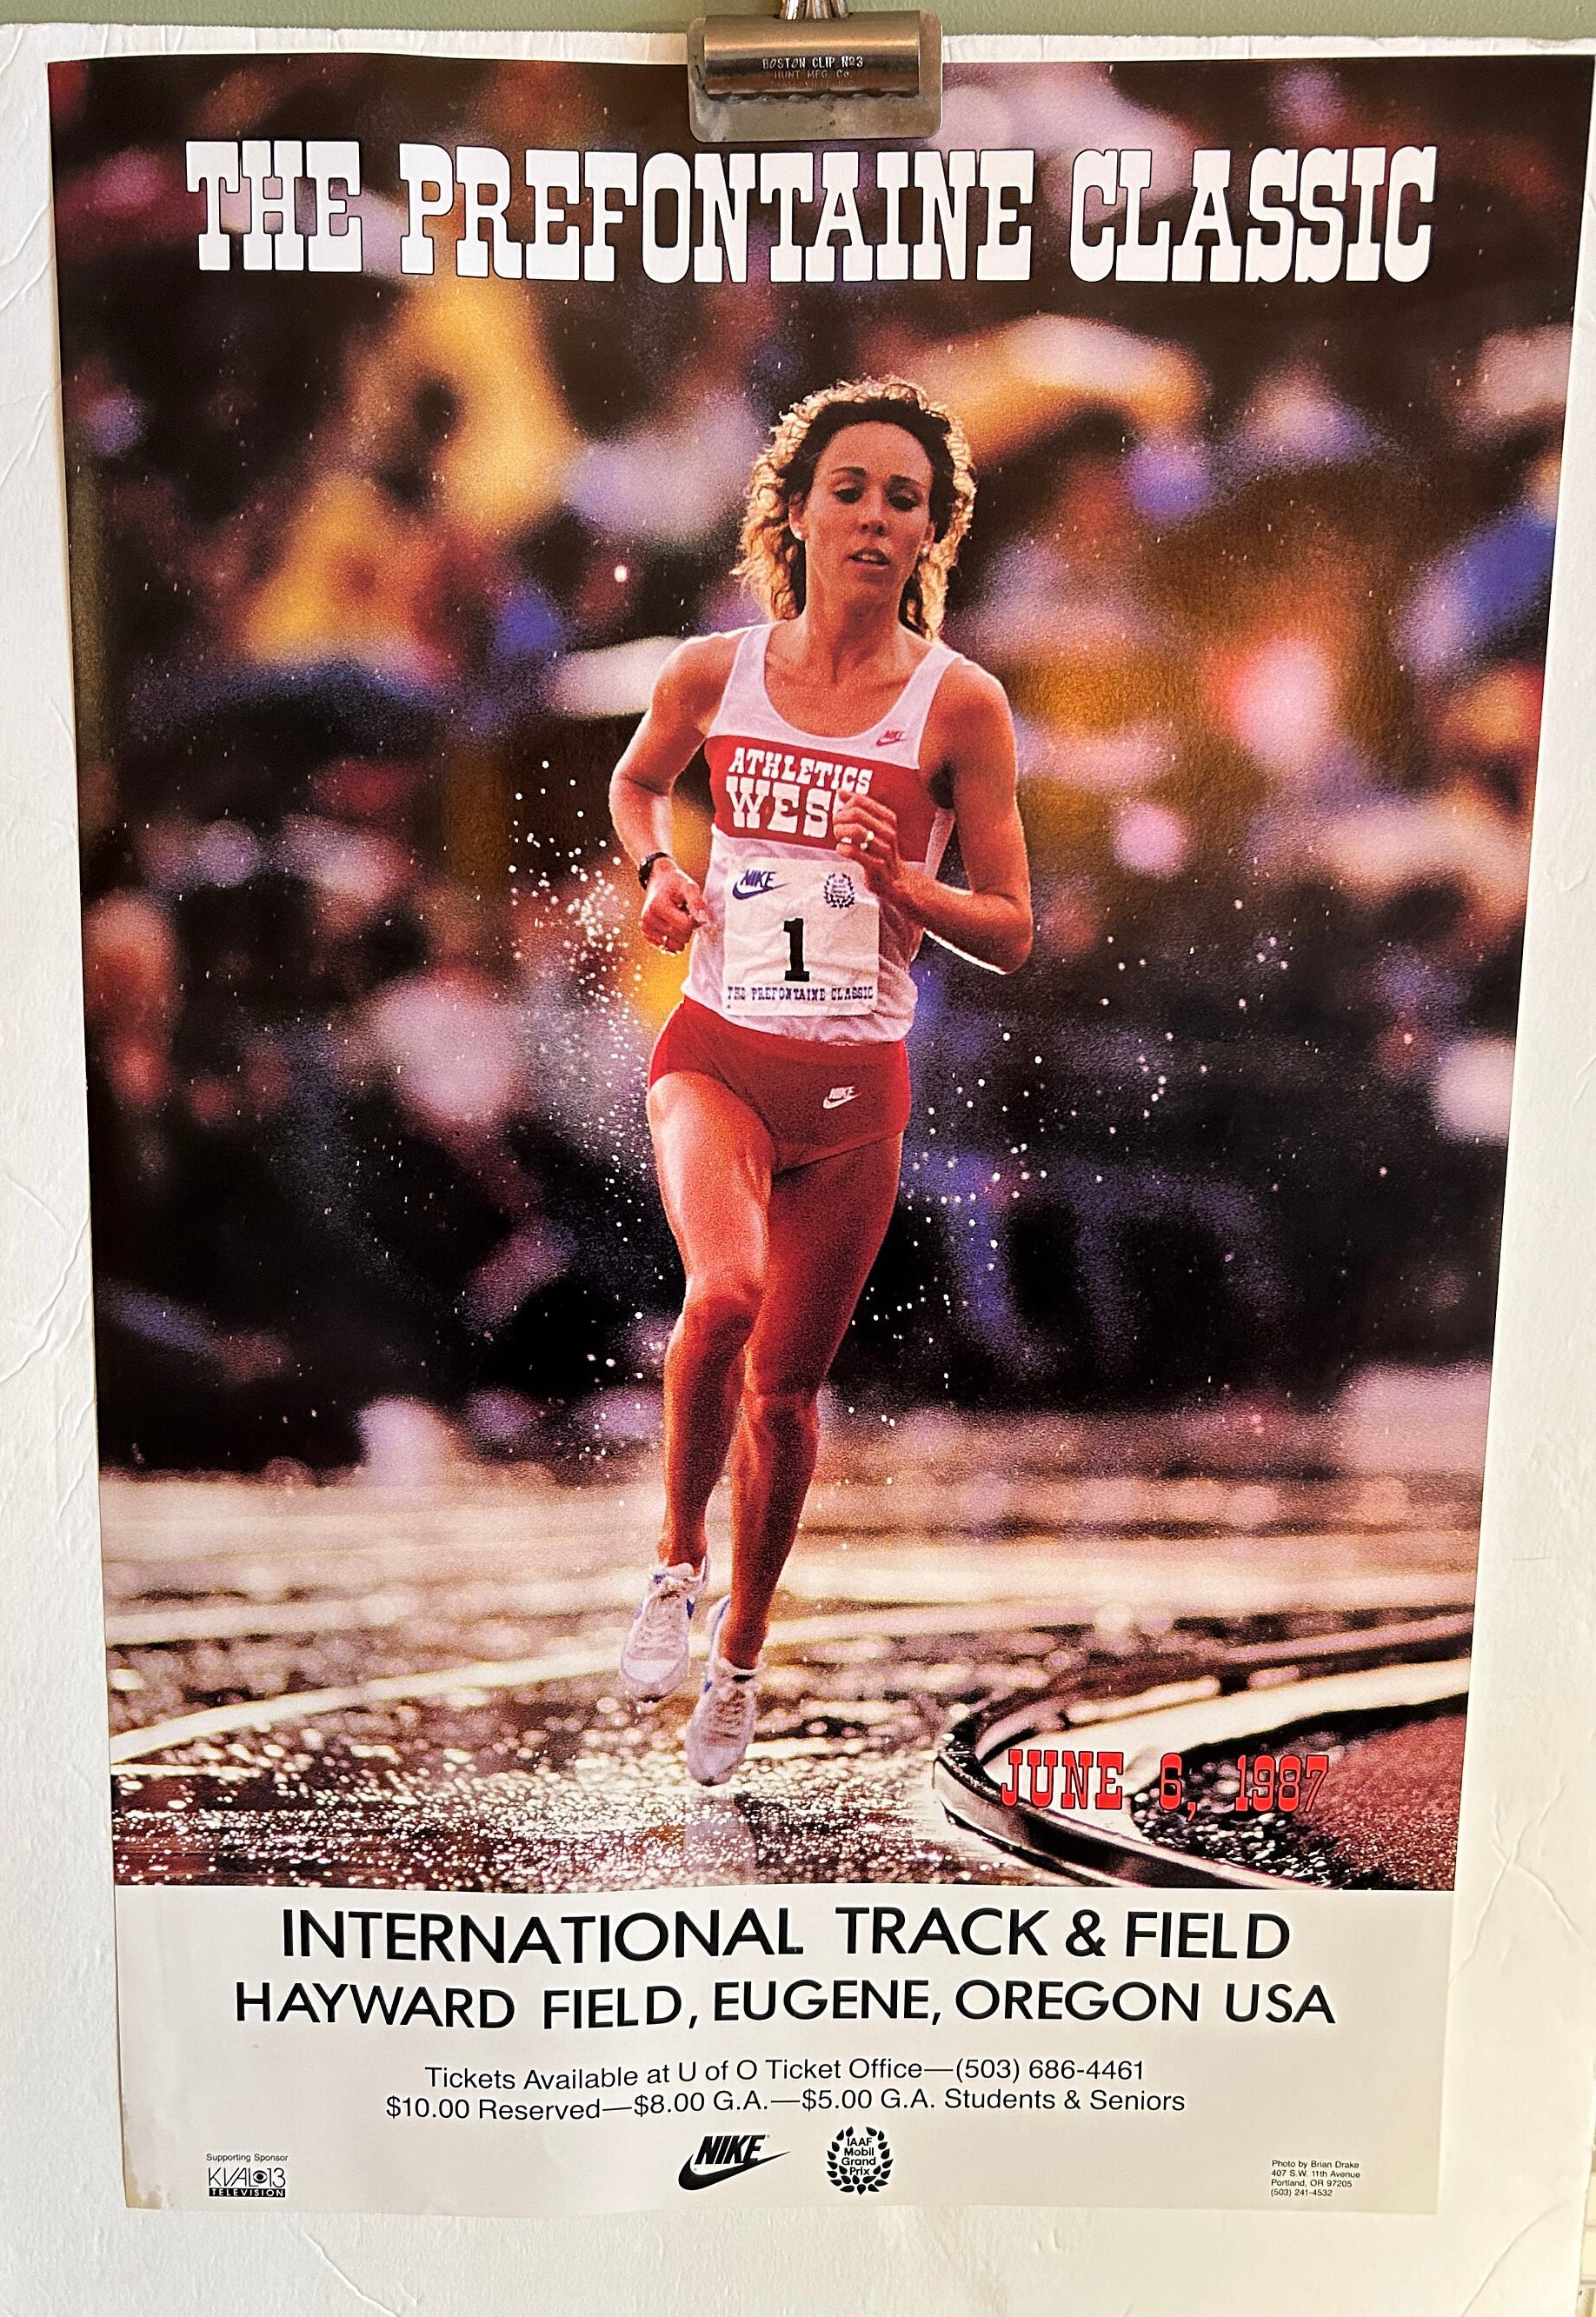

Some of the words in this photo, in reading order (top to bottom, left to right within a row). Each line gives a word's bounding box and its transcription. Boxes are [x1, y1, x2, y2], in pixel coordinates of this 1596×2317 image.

[762, 57, 806, 69] BOSTON
[812, 56, 835, 68] CLIP
[774, 70, 800, 79] HUNT
[185, 140, 362, 273] THE
[399, 143, 1034, 284] PREFONTAINE
[1070, 146, 1437, 283] CLASSIC
[728, 747, 873, 795] ATHLETICS
[740, 869, 778, 887] NIKE
[783, 917, 810, 982] 1
[752, 987, 825, 1001] PREFONTAINE
[831, 986, 873, 1000] CLASSIC
[1001, 1748, 1123, 1810] JUNE
[1158, 1753, 1196, 1821] 6,
[1234, 1754, 1329, 1813] 1987
[283, 1908, 803, 1965] INTERNATIONAL
[835, 1907, 1050, 1957] TRACK
[1064, 1908, 1107, 1958] &
[1125, 1911, 1290, 1960] FIELD
[236, 1981, 515, 2030] HAYWARD
[543, 1985, 698, 2030] FIELD,
[714, 1980, 941, 2026] EUGENE,
[955, 1980, 1199, 2022] OREGON
[1225, 1983, 1336, 2025] USA
[425, 2067, 515, 2089] Tickets
[523, 2067, 638, 2090] Available
[647, 2065, 670, 2084] at
[678, 2061, 696, 2082] U
[705, 2061, 728, 2081] of
[736, 2060, 757, 2080] O
[765, 2059, 841, 2080] Ticket
[1028, 2060, 1143, 2081] 686-4461
[386, 2095, 469, 2120] $10.00
[881, 2088, 935, 2109] G.A.
[944, 2088, 1055, 2110] Students
[1063, 2089, 1081, 2110] &
[1089, 2089, 1185, 2111] Seniors
[695, 2134, 766, 2165] NIKE
[847, 2137, 873, 2147] IAAF
[206, 2154, 251, 2162] Supporting
[254, 2154, 289, 2162] Sponsor
[844, 2147, 874, 2156] Mobil
[841, 2156, 876, 2166] Grand
[1298, 2160, 1307, 2169] by
[209, 2167, 259, 2187] KVAL
[849, 2166, 870, 2175] Prix
[1271, 2179, 1307, 2187] Portland,
[211, 2188, 283, 2197] TELEVISION
